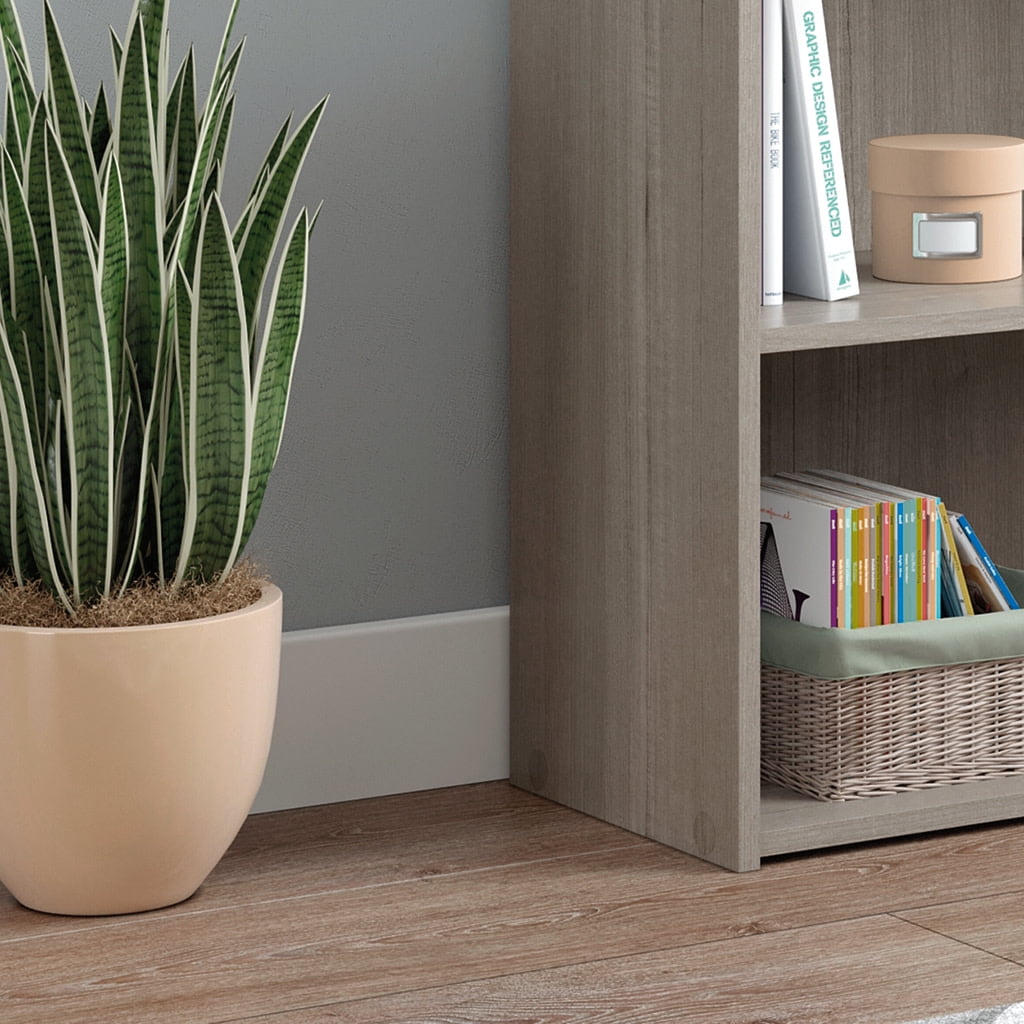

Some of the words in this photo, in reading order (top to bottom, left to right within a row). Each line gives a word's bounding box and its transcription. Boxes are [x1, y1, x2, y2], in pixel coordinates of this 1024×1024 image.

[803, 10, 822, 78] GRAPHIC
[770, 112, 780, 126] THE
[812, 81, 829, 136] DESIGN
[820, 140, 842, 237] REFERENCED
